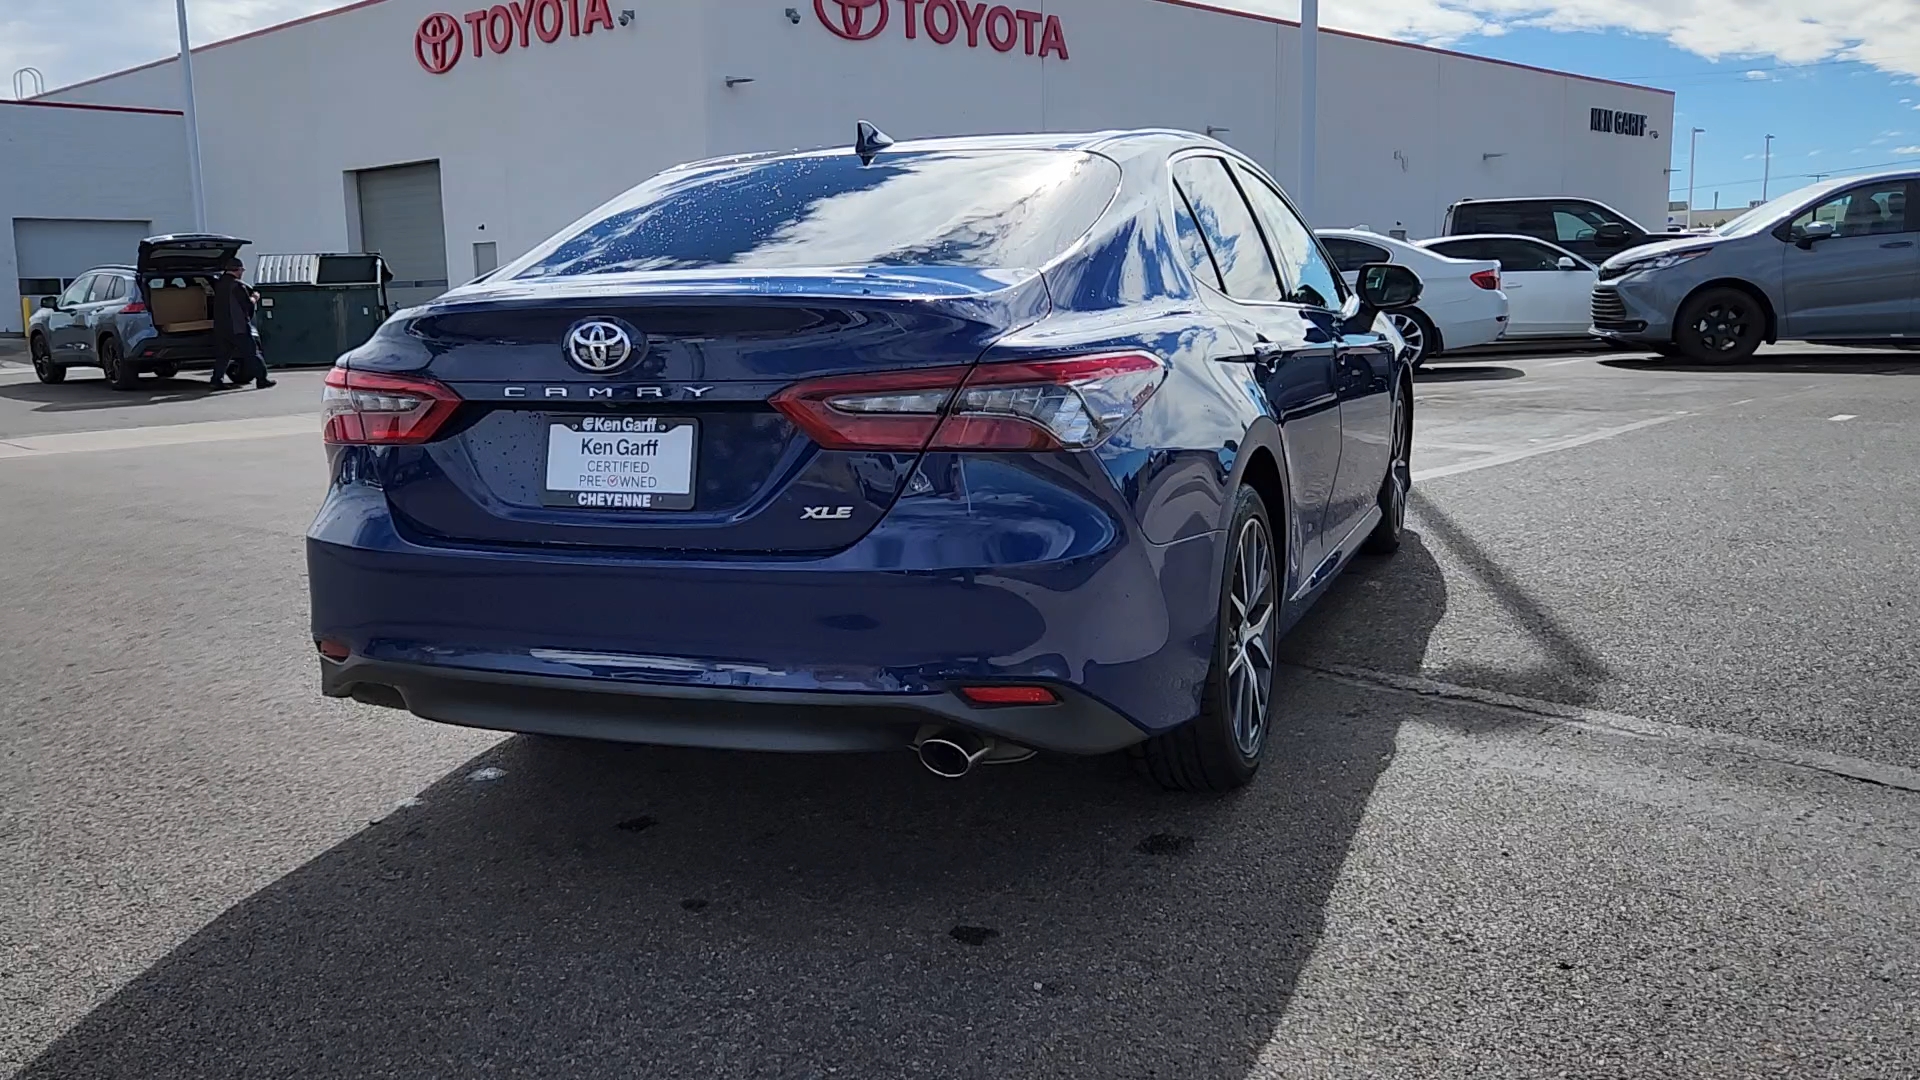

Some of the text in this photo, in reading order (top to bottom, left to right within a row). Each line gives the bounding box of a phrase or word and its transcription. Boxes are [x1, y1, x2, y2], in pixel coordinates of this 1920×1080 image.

[464, 0, 614, 57] TOYOTA
[897, 0, 1069, 60] TOYOTA
[1590, 107, 1613, 133] KEN
[504, 386, 714, 398] CAMRY
[594, 417, 658, 433] Ken Garff
[581, 437, 659, 456] Ken Garff
[587, 460, 650, 473] CERTIFIED
[577, 492, 652, 508] CHEYENNE
[800, 506, 854, 519] XLE
